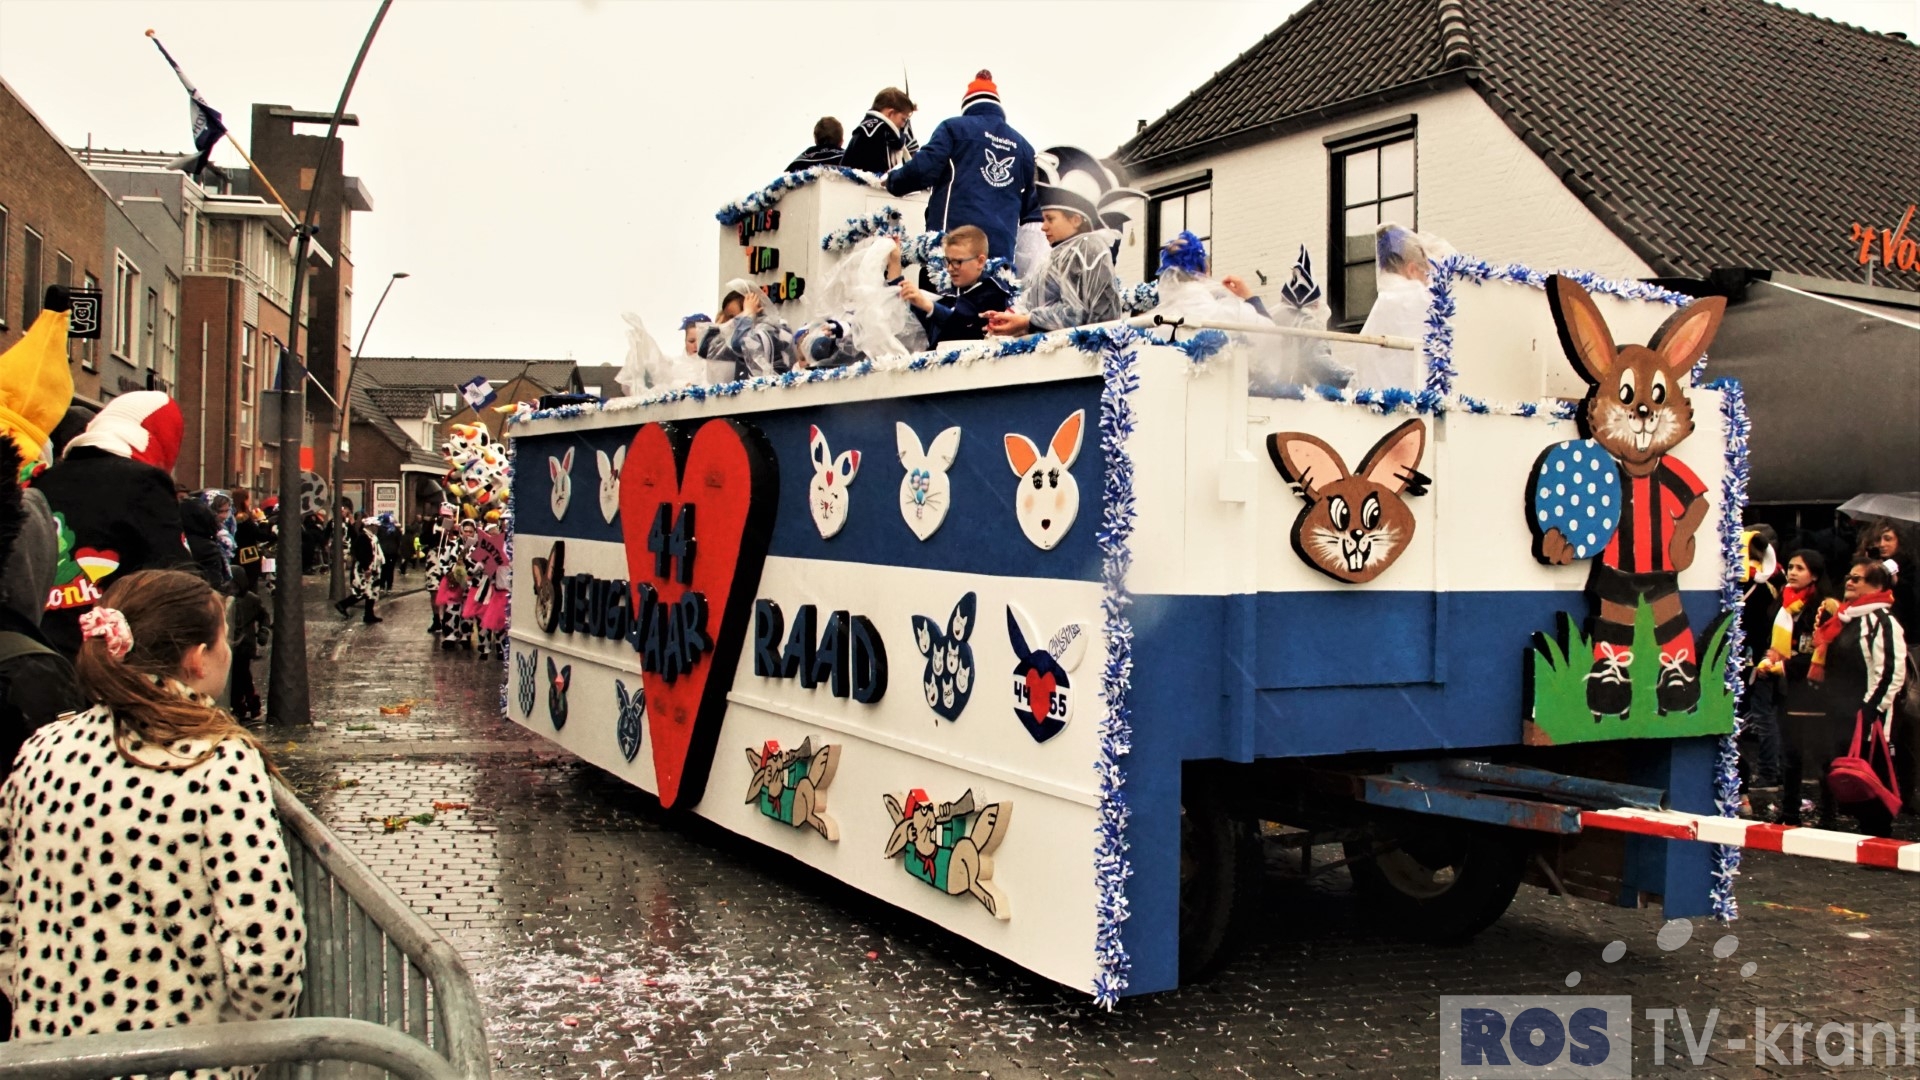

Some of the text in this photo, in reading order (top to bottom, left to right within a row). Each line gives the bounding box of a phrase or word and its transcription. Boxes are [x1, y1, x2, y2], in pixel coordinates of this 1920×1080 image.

[1880, 204, 1920, 272] Vo
[648, 502, 697, 585] 44
[631, 583, 714, 684] JAAR
[754, 598, 888, 704] RAAD
[1013, 680, 1032, 706] 44
